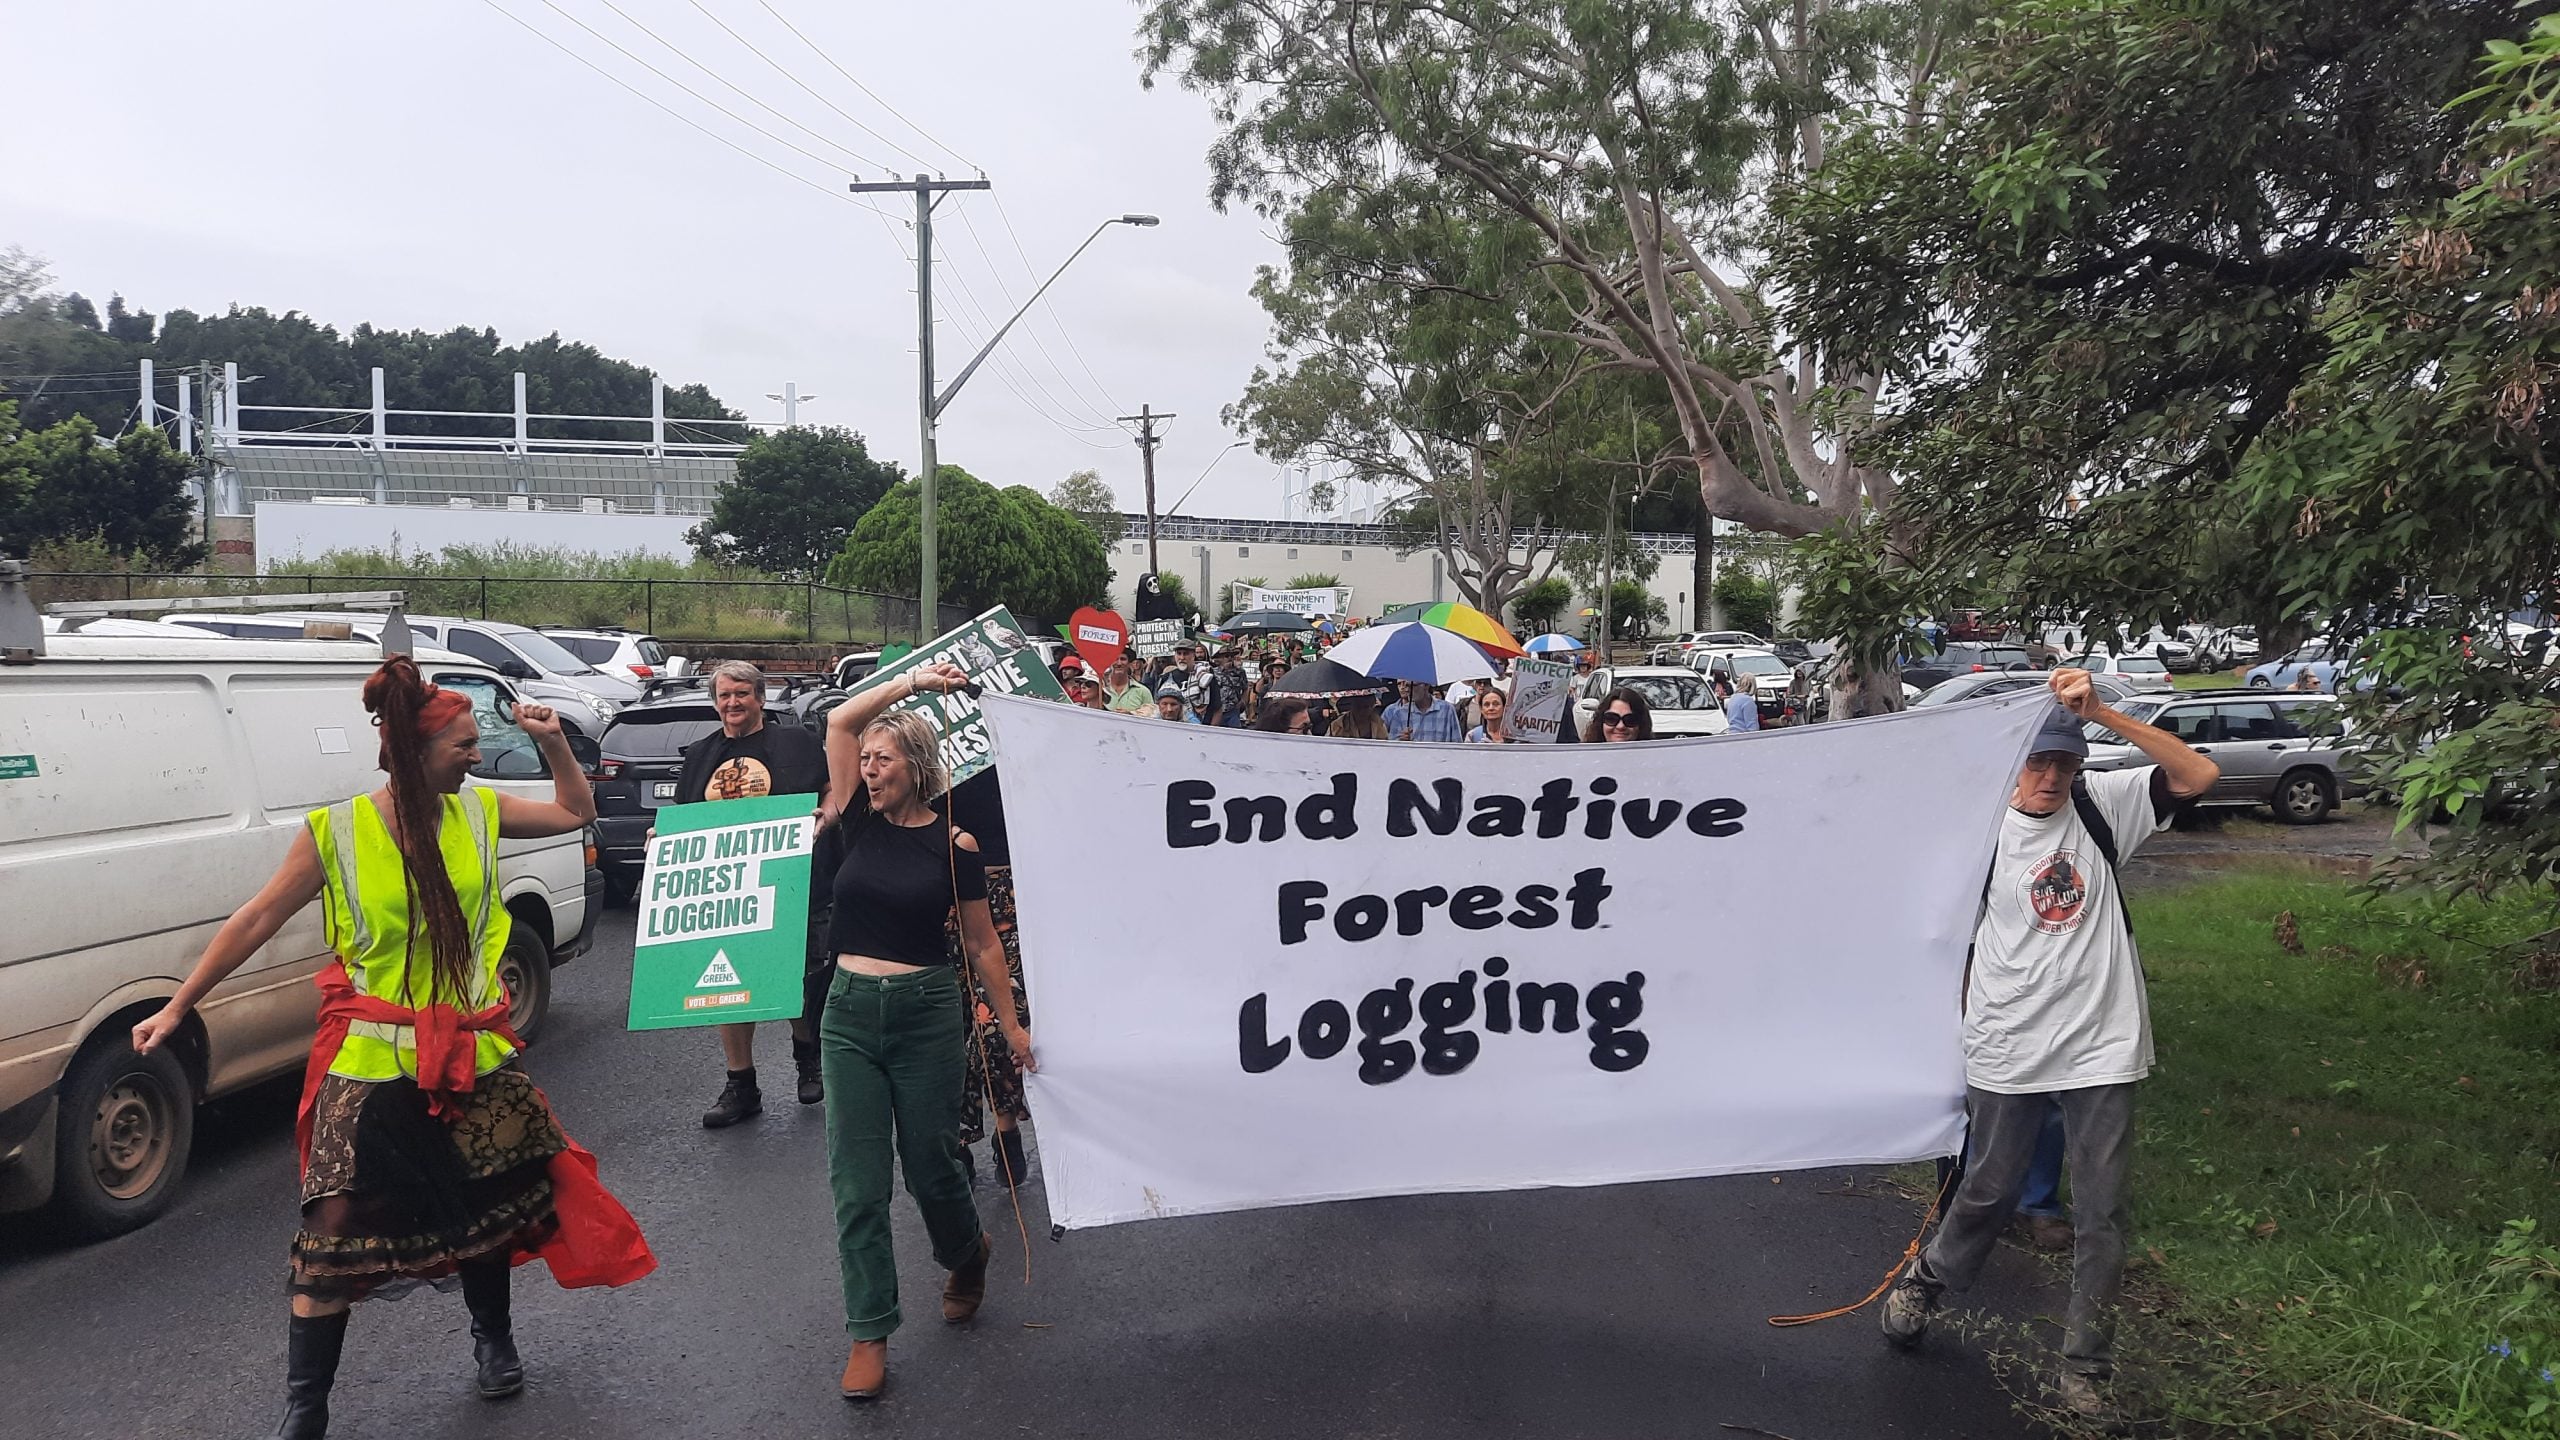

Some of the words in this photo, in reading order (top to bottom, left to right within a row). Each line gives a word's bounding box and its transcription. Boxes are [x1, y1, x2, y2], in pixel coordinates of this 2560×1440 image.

[1261, 594, 1327, 604] ENVIRONMENT
[1276, 602, 1312, 612] CENTRE
[1136, 621, 1168, 633] PROTECT
[1082, 629, 1117, 643] FOREST
[1137, 633, 1152, 644] OUR
[1153, 631, 1179, 642] NATIVE
[1138, 644, 1169, 654] FORESTS
[1515, 658, 1573, 680] PROTECT
[1513, 715, 1561, 735] HABITAT
[1165, 772, 1358, 848] End
[1385, 776, 1748, 840] Native
[656, 835, 707, 867] END
[714, 822, 802, 860] NATIVE
[651, 861, 747, 902] FOREST
[2034, 885, 2055, 899] SAVE
[1278, 867, 1614, 946] Forest
[2037, 888, 2079, 912] WALLUM
[647, 895, 759, 938] LOGGING
[712, 963, 727, 973] THE
[703, 973, 734, 984] GREENS
[688, 997, 706, 1007] VOTE
[719, 993, 746, 1004] GREENS
[1238, 956, 1650, 1086] Logging
